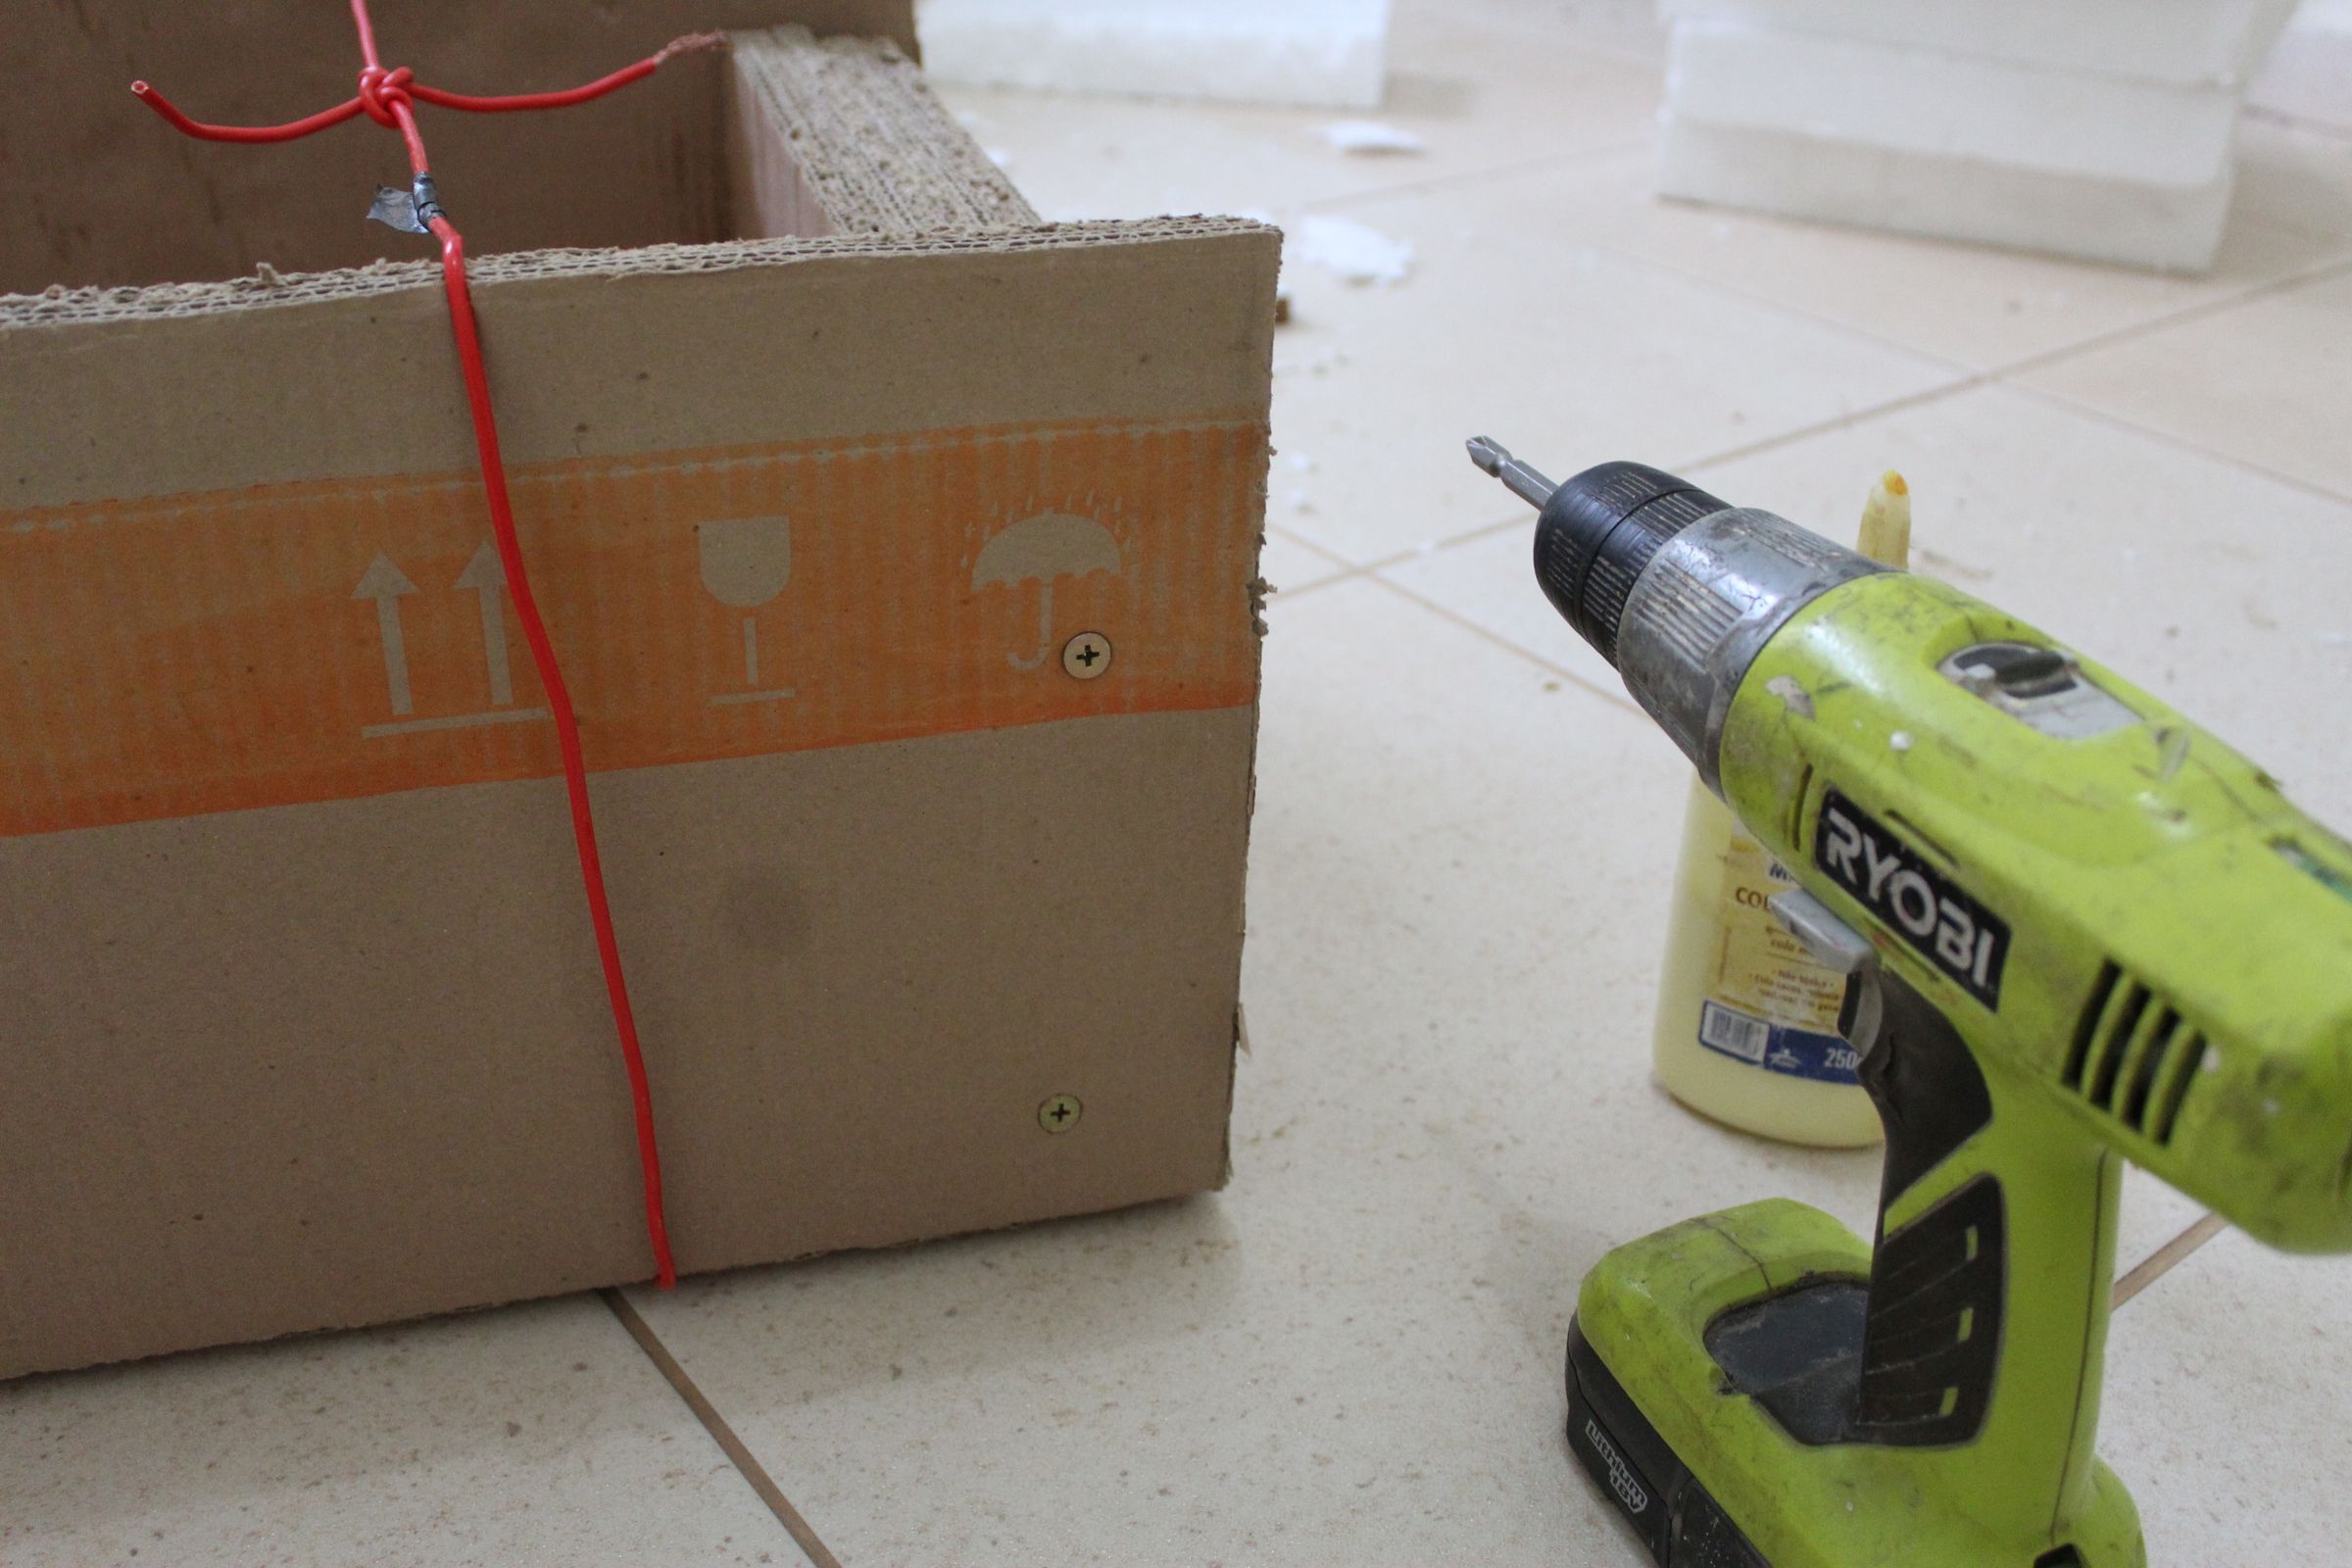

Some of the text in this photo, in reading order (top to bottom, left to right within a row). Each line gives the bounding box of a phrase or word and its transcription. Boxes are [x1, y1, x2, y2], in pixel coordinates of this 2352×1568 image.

[1826, 807, 1994, 988] RYOBI
[1585, 1419, 1648, 1507] Lithium
[1609, 1472, 1642, 1513] 18V
